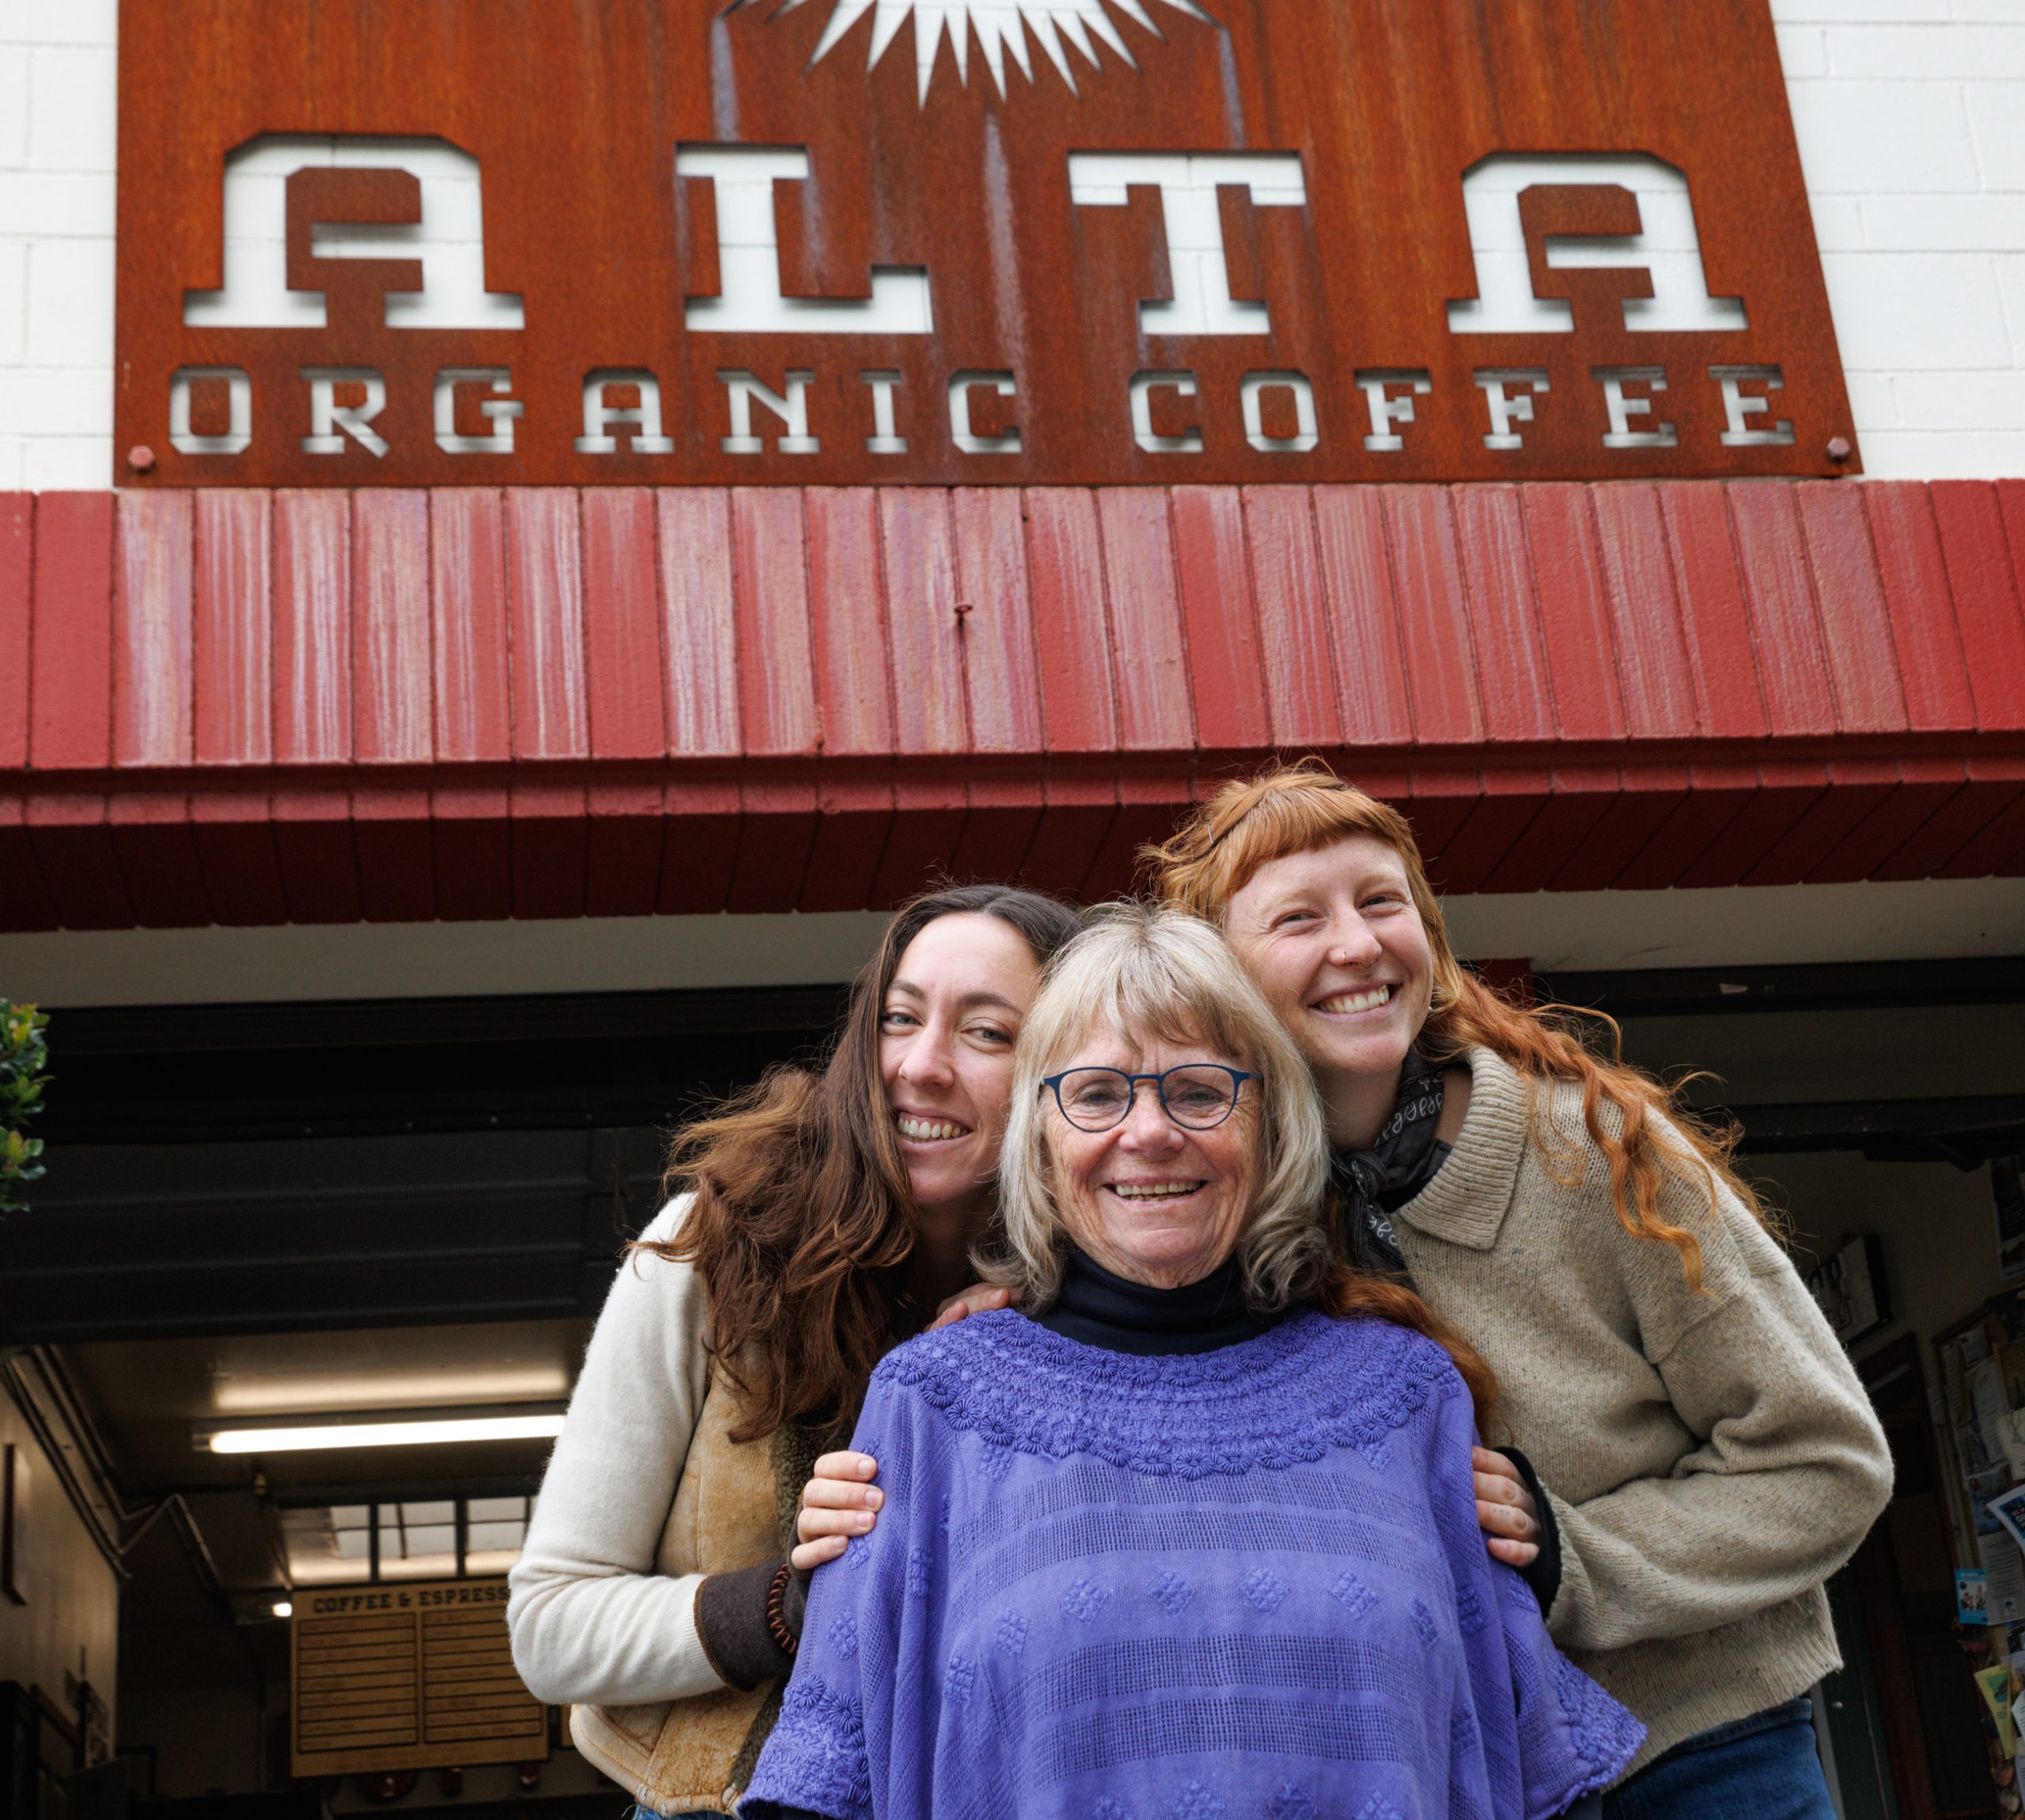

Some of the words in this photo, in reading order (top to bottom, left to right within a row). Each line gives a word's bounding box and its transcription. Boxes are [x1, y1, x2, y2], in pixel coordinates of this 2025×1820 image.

[184, 131, 1748, 335] ALTA
[168, 365, 1022, 459] ORGANIC
[1130, 364, 1795, 453] COFFEE
[312, 1593, 392, 1614] COFFEE
[418, 1586, 510, 1606] ESPRESS
